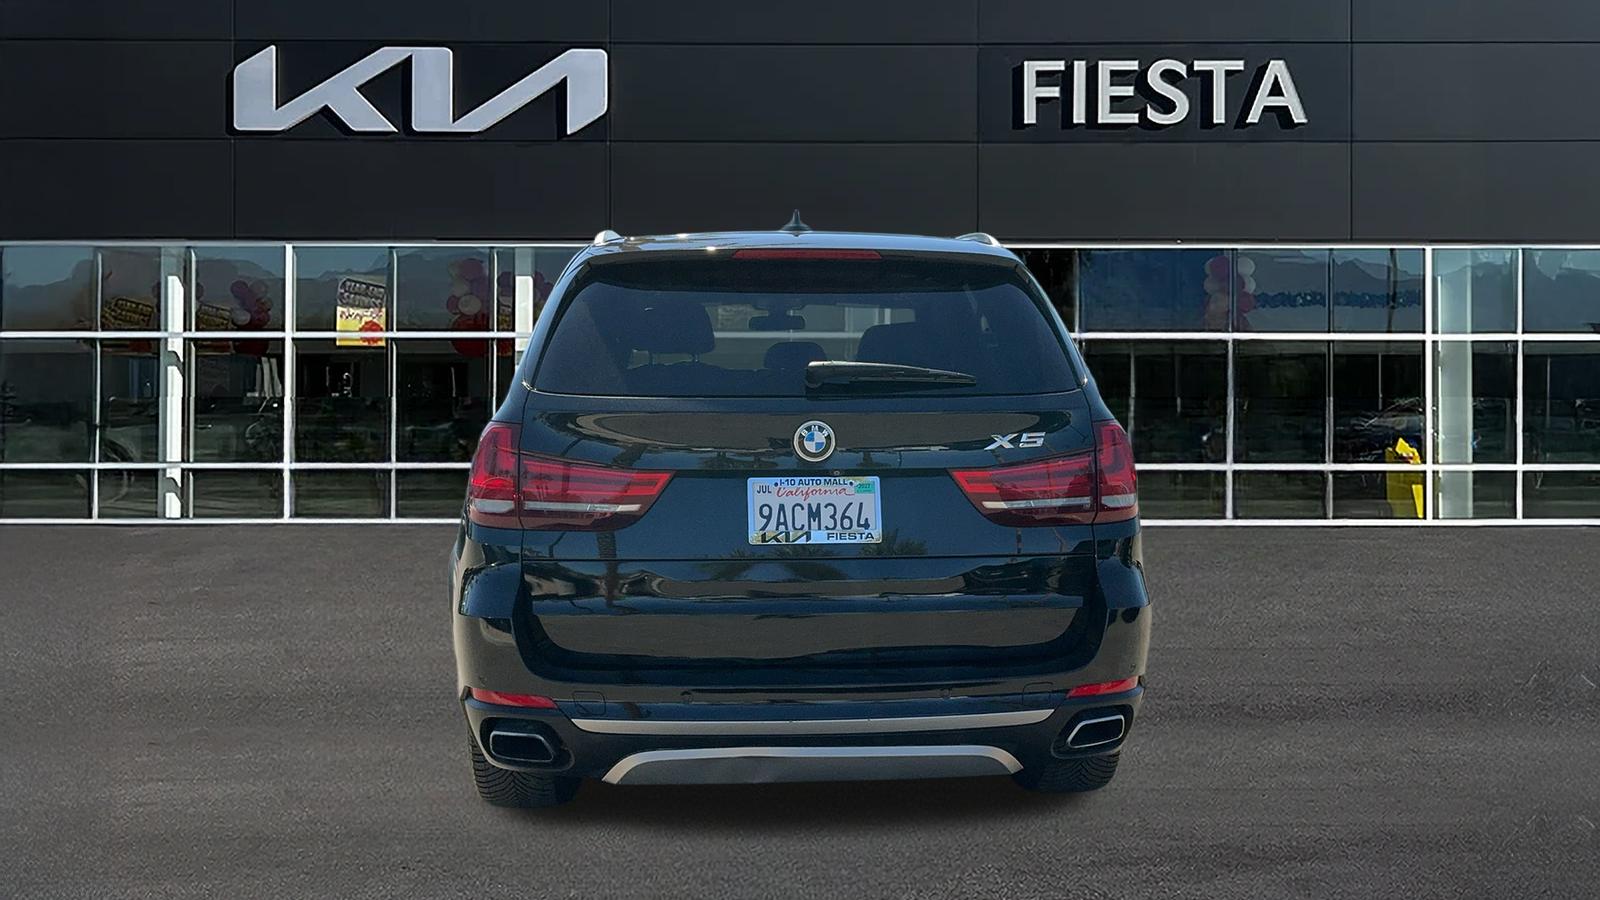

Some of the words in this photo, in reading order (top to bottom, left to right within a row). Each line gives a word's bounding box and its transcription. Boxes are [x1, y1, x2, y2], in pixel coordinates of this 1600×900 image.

[233, 44, 608, 135] KIA
[1023, 59, 1308, 124] FIESTA
[800, 425, 829, 437] BMW
[984, 431, 1046, 451] X5
[757, 485, 772, 494] JUL
[779, 478, 796, 486] I-10
[797, 478, 822, 486] AUTO
[823, 478, 848, 486] MALL
[776, 486, 855, 501] California
[759, 502, 871, 531] 9ACM364
[761, 531, 811, 543] KIA
[827, 532, 874, 541] FIESTA
